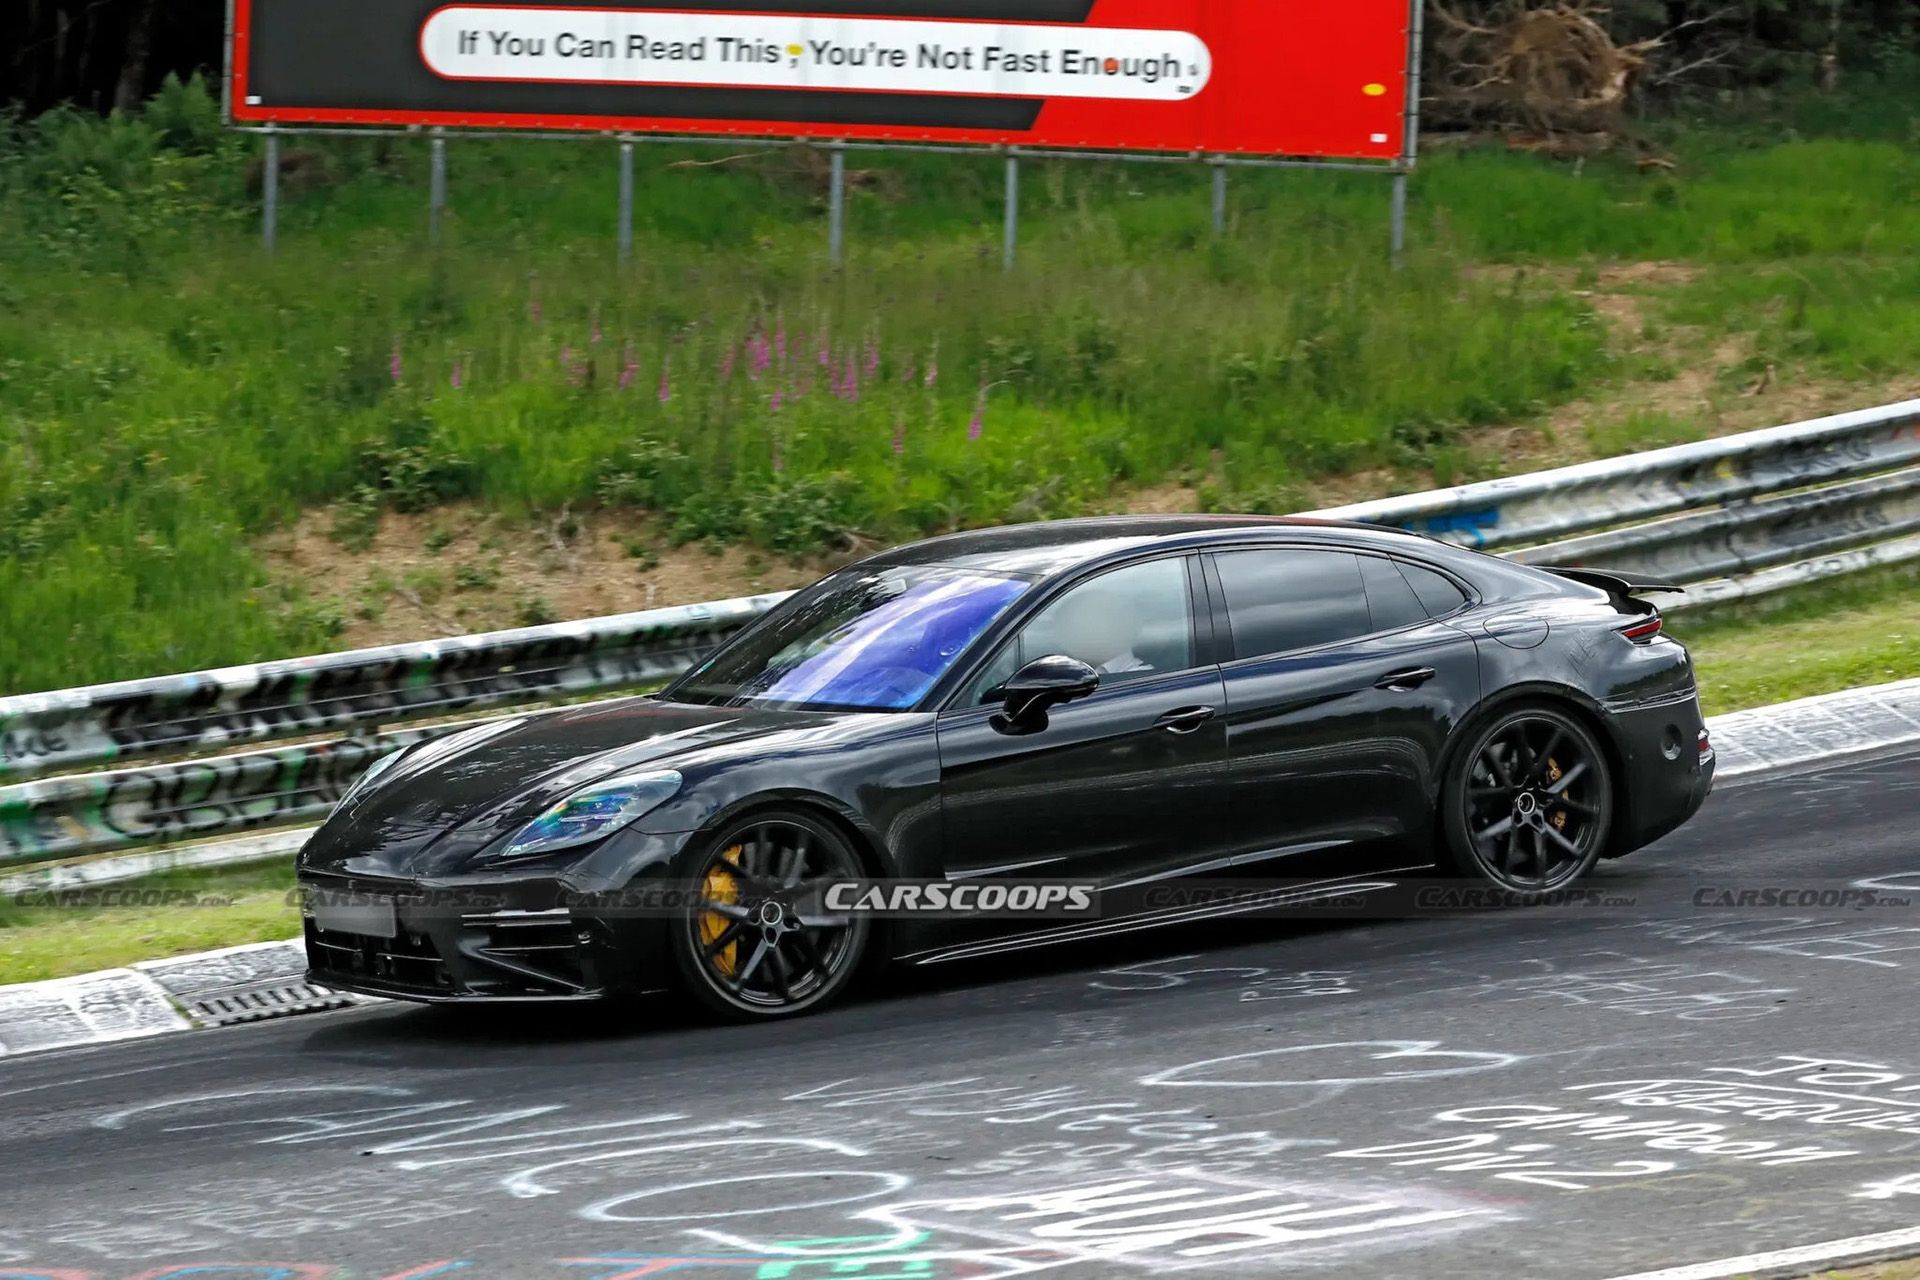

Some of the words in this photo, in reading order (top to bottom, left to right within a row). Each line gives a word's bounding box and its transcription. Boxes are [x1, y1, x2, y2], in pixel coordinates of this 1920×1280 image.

[458, 30, 480, 55] If
[487, 31, 546, 57] You
[554, 32, 616, 58] Can
[625, 34, 708, 62] Read
[808, 40, 907, 68] You're
[917, 43, 973, 70] Not
[982, 46, 1052, 74] Fast
